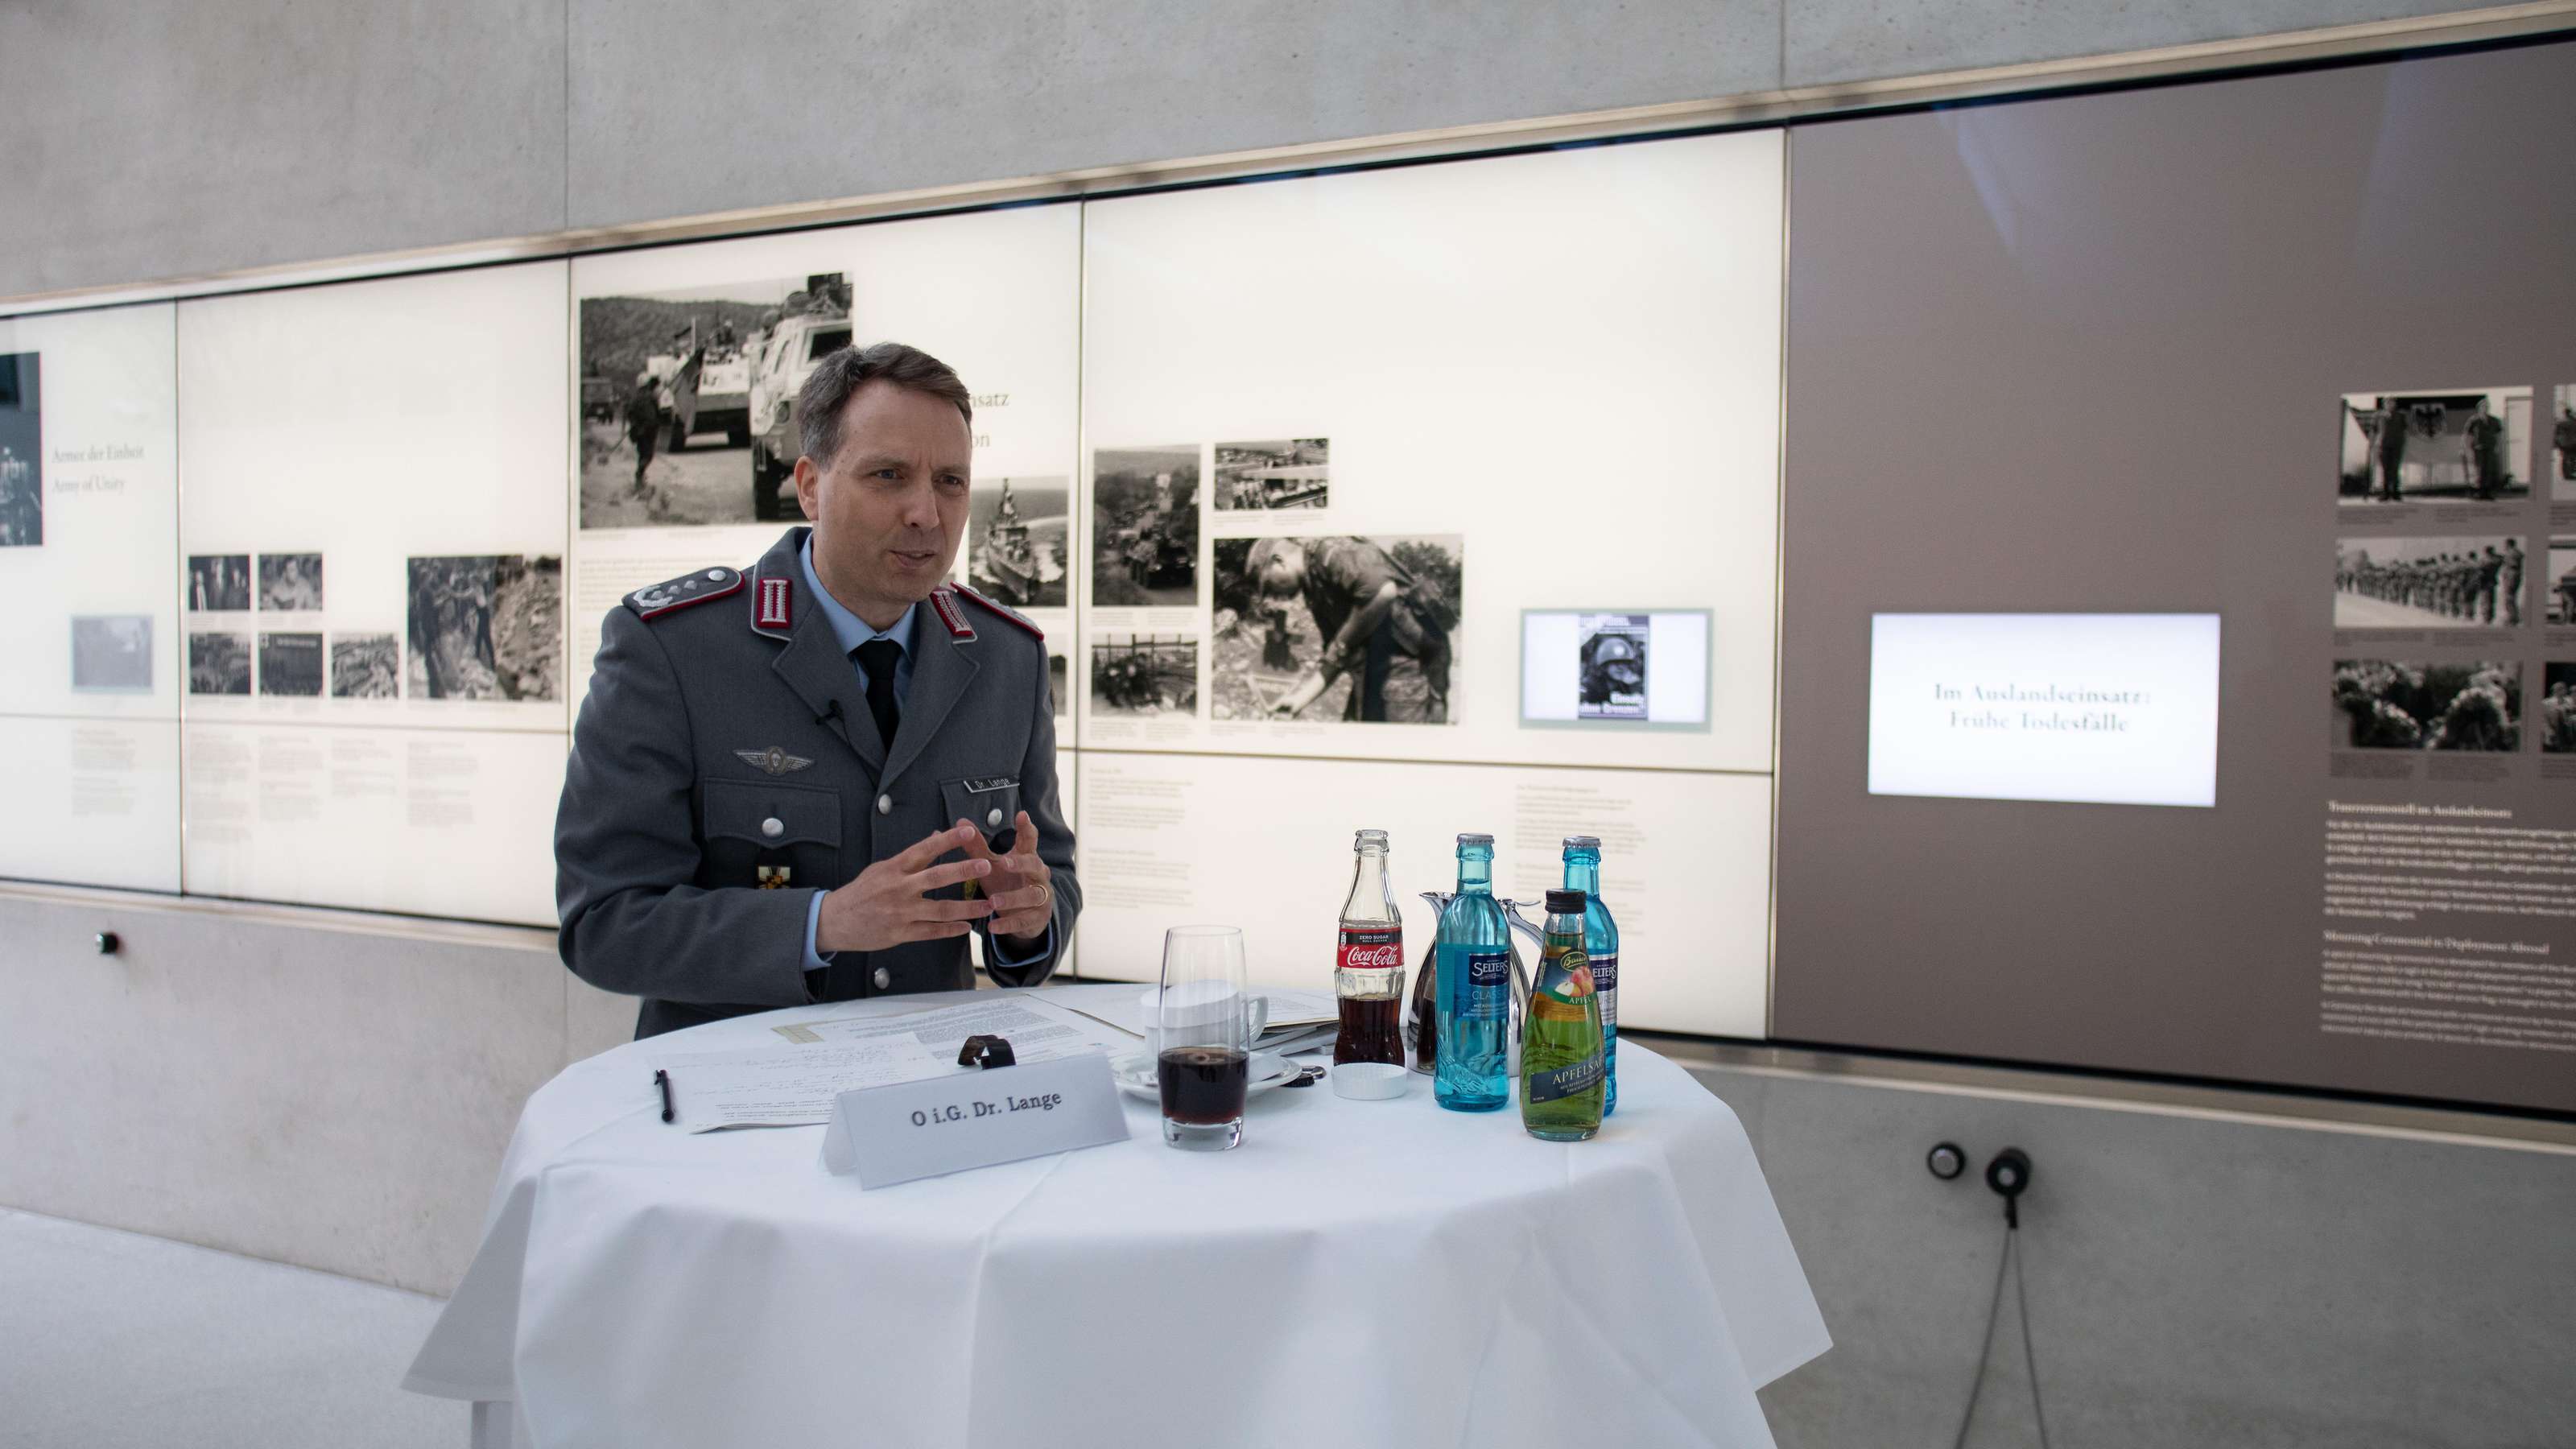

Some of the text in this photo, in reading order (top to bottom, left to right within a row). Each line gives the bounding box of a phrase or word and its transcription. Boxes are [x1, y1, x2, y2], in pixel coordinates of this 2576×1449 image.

[1934, 683, 1962, 701] Im
[1472, 960, 1509, 976] SELTERS
[1593, 964, 1616, 979] ELTERS
[911, 1092, 1062, 1127] O i.G. Dr. Lange
